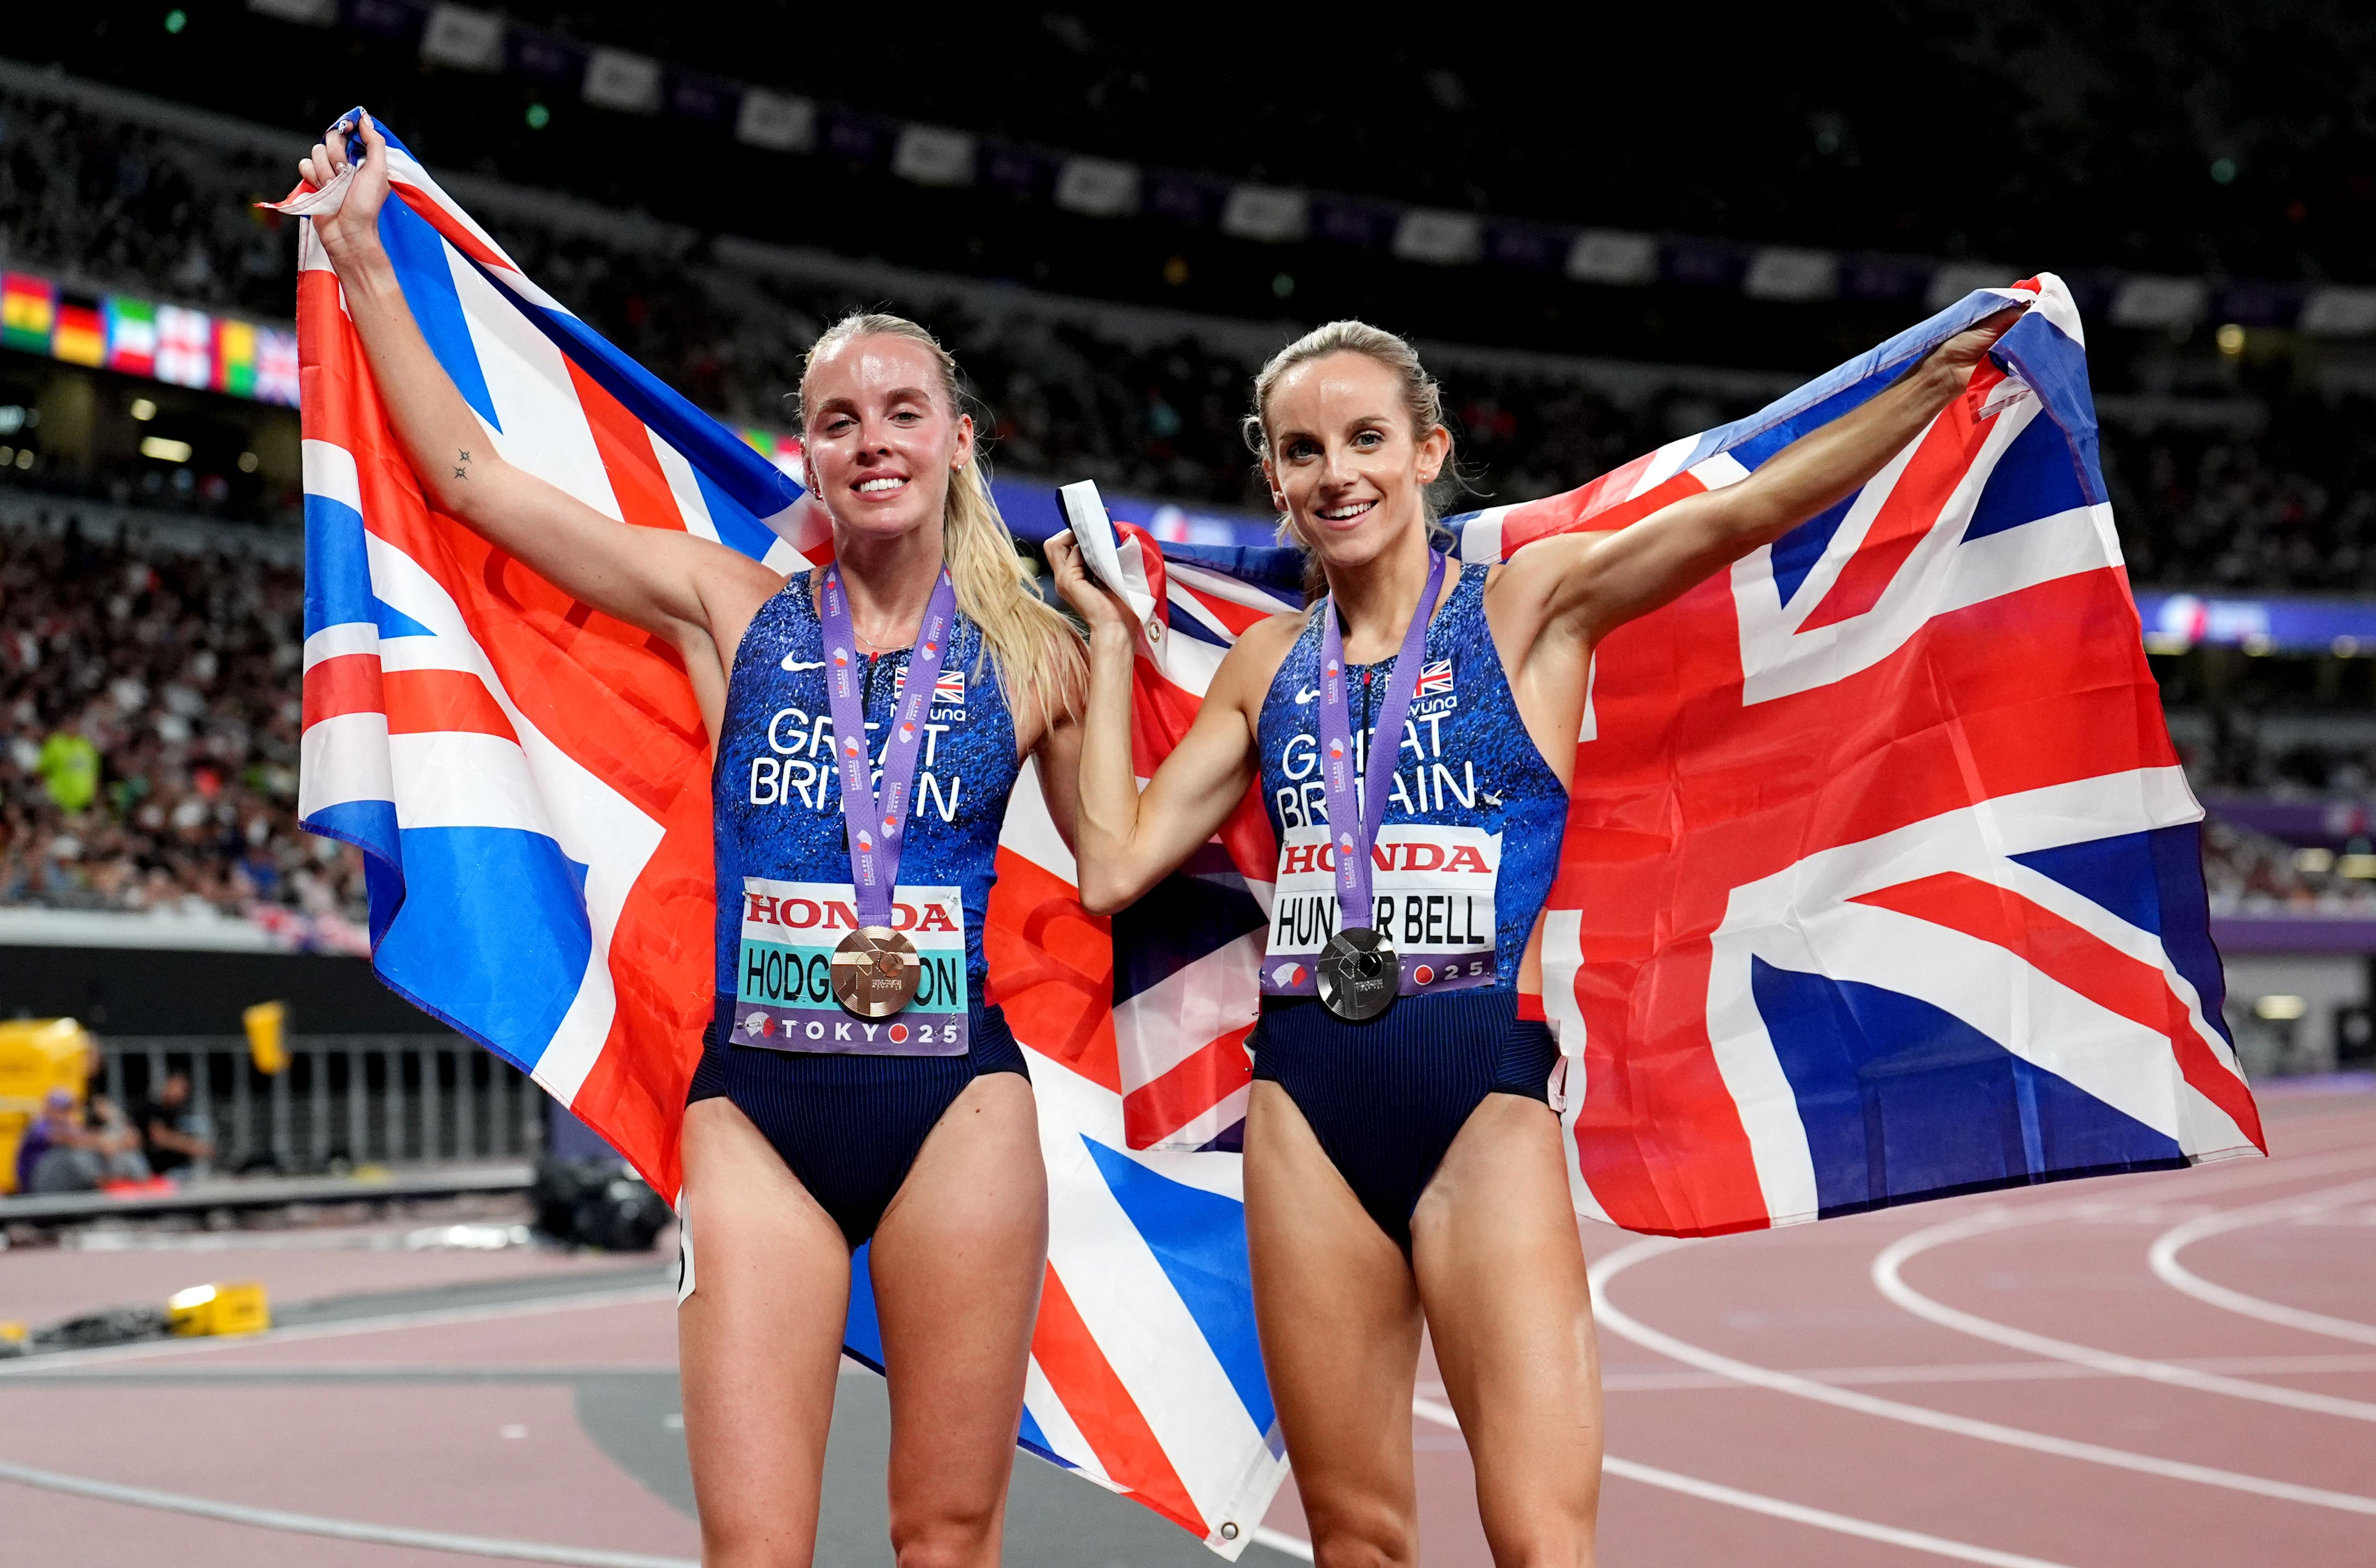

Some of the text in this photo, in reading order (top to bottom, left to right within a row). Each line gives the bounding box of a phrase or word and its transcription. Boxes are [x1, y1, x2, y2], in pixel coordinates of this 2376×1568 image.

[890, 702, 966, 721] Nuna
[1407, 696, 1457, 716] vuna
[768, 707, 950, 767] GRT
[1282, 710, 1452, 780] GAT
[750, 756, 960, 822] BRIN
[1276, 760, 1476, 829] BRTAIN
[747, 894, 959, 931] HONDA
[1277, 896, 1485, 946] HUNR BELL
[746, 948, 957, 1006] HODGON
